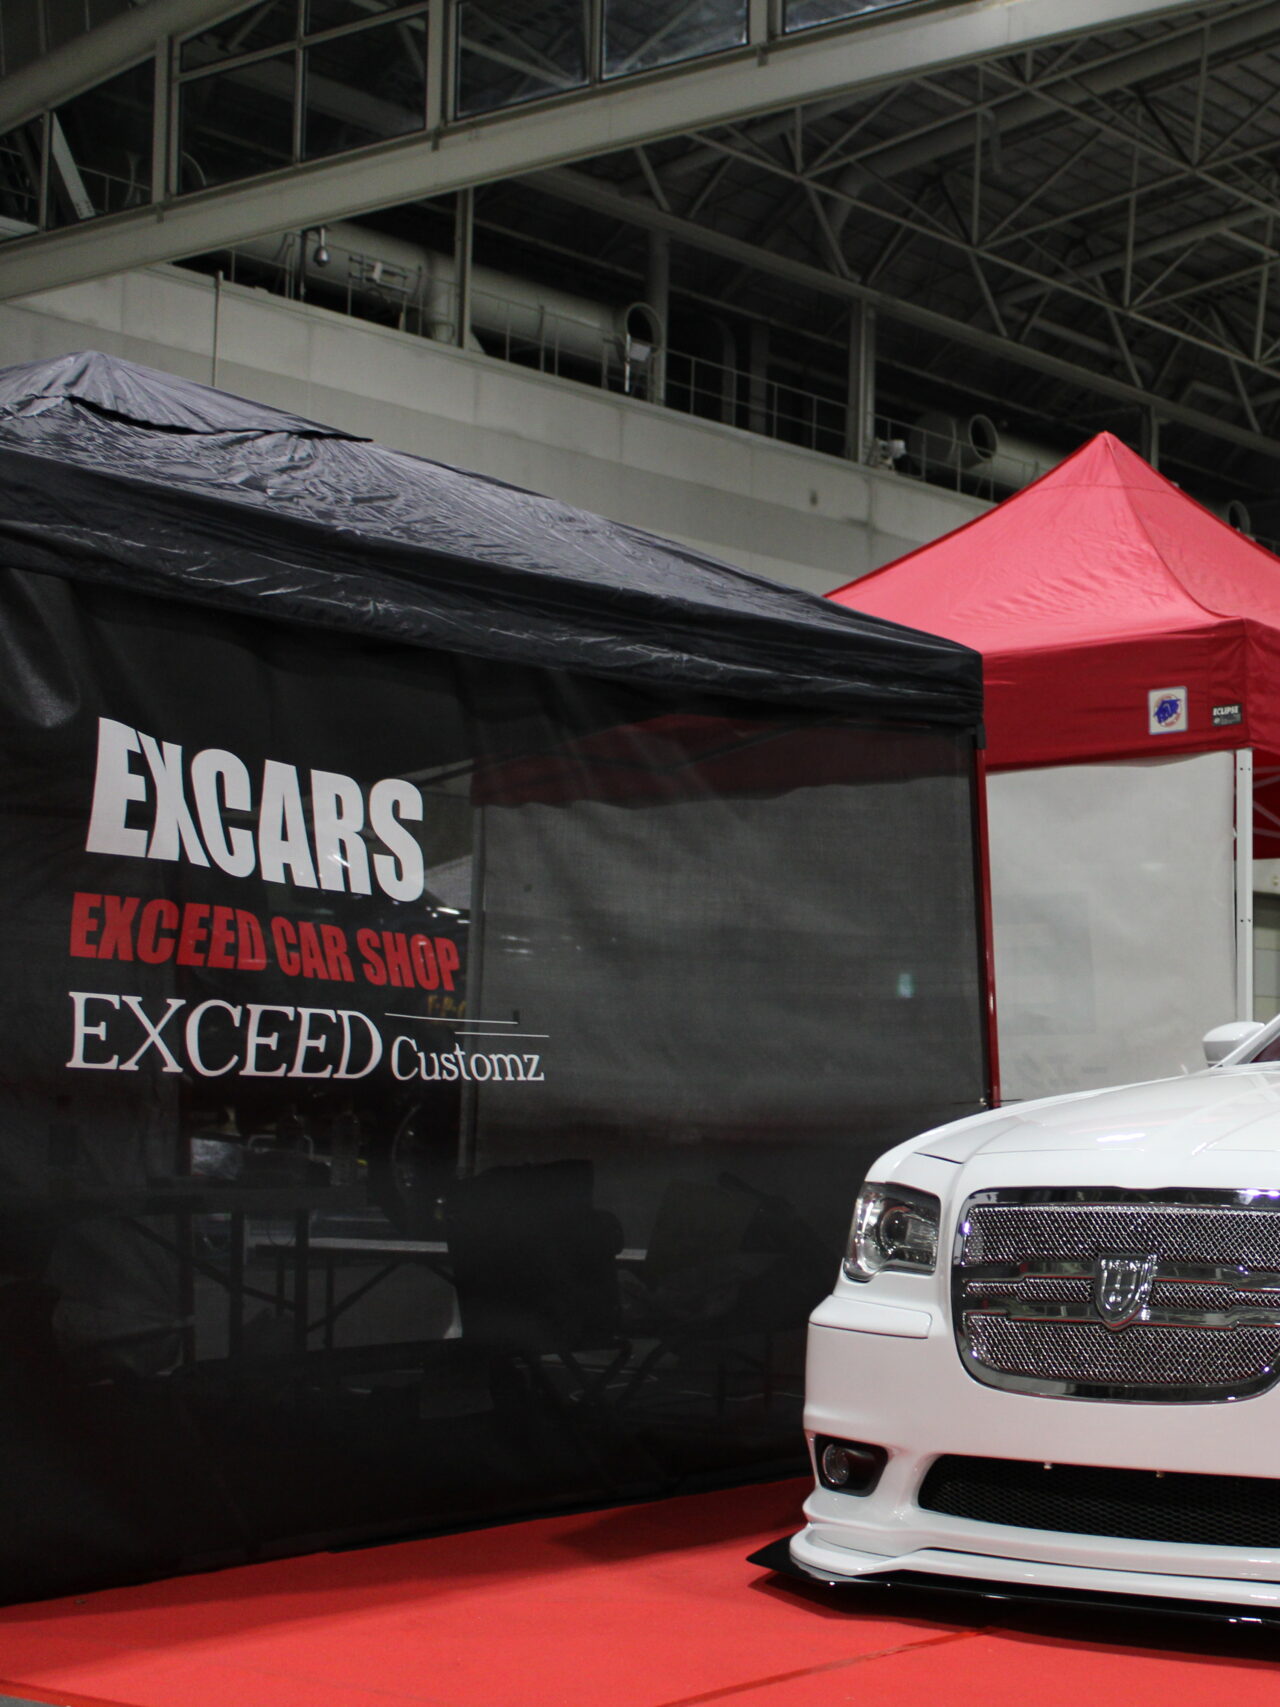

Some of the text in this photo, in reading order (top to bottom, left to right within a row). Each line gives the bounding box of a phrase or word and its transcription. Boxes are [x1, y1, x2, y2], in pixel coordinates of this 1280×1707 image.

[1213, 705, 1239, 716] ECLIPSE
[86, 717, 425, 902] EXCARS
[69, 892, 460, 991] EXCEED CAR SHOP
[66, 991, 545, 1081] EXCEED Customz
